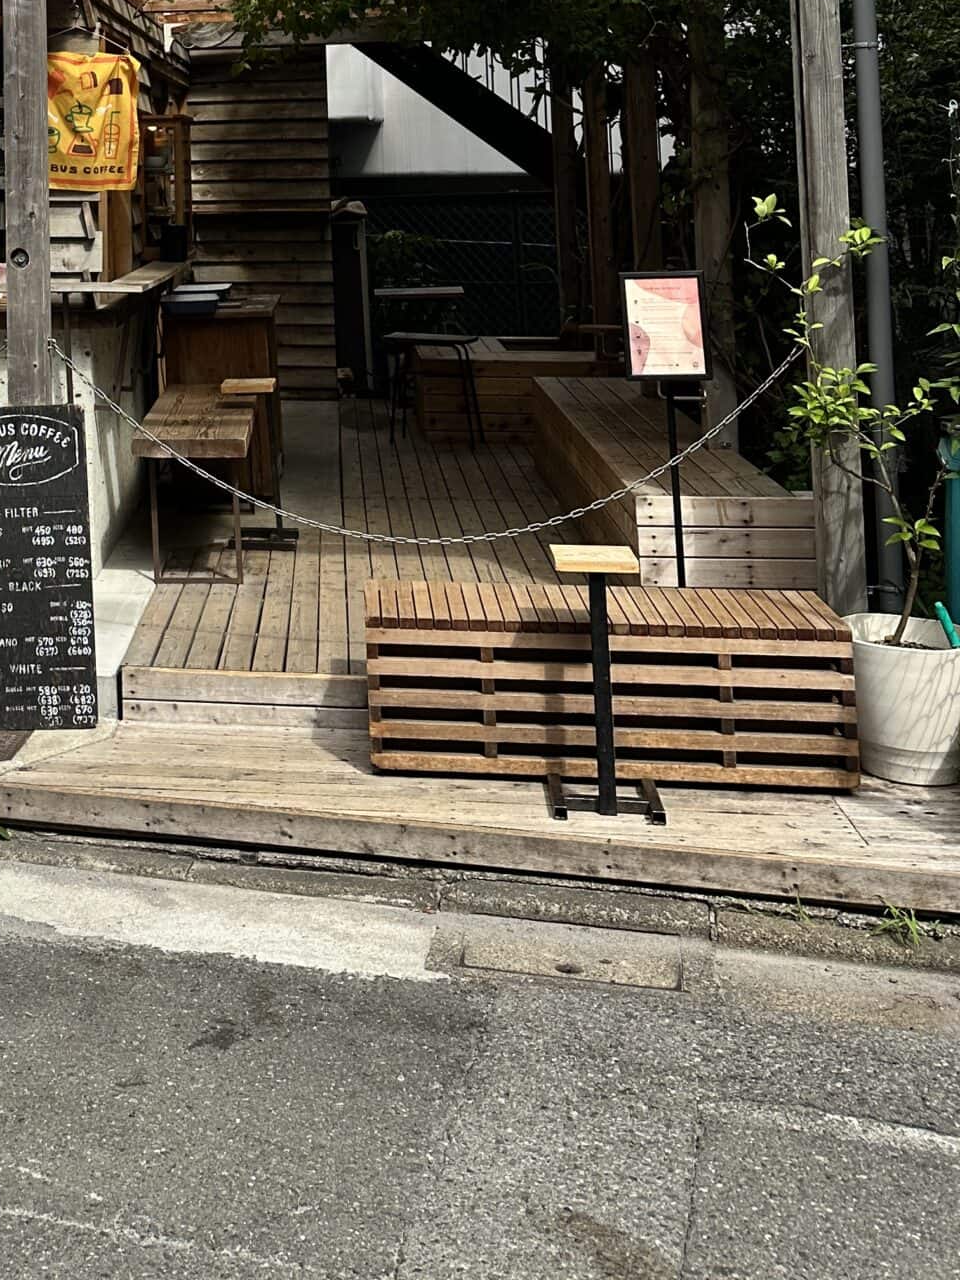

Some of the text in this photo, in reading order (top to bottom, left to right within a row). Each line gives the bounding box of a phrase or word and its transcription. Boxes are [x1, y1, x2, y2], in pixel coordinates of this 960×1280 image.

[50, 163, 125, 175] BUS COFFEE
[21, 423, 71, 448] COFFEE
[4, 506, 39, 518] FILTER
[34, 525, 51, 535] 450
[8, 582, 42, 593] BLACK
[38, 637, 54, 646] 570
[9, 664, 43, 674] WHITE
[38, 686, 58, 695] 580
[37, 695, 61, 705] (638)
[40, 706, 58, 716] 630
[75, 705, 93, 715] 670
